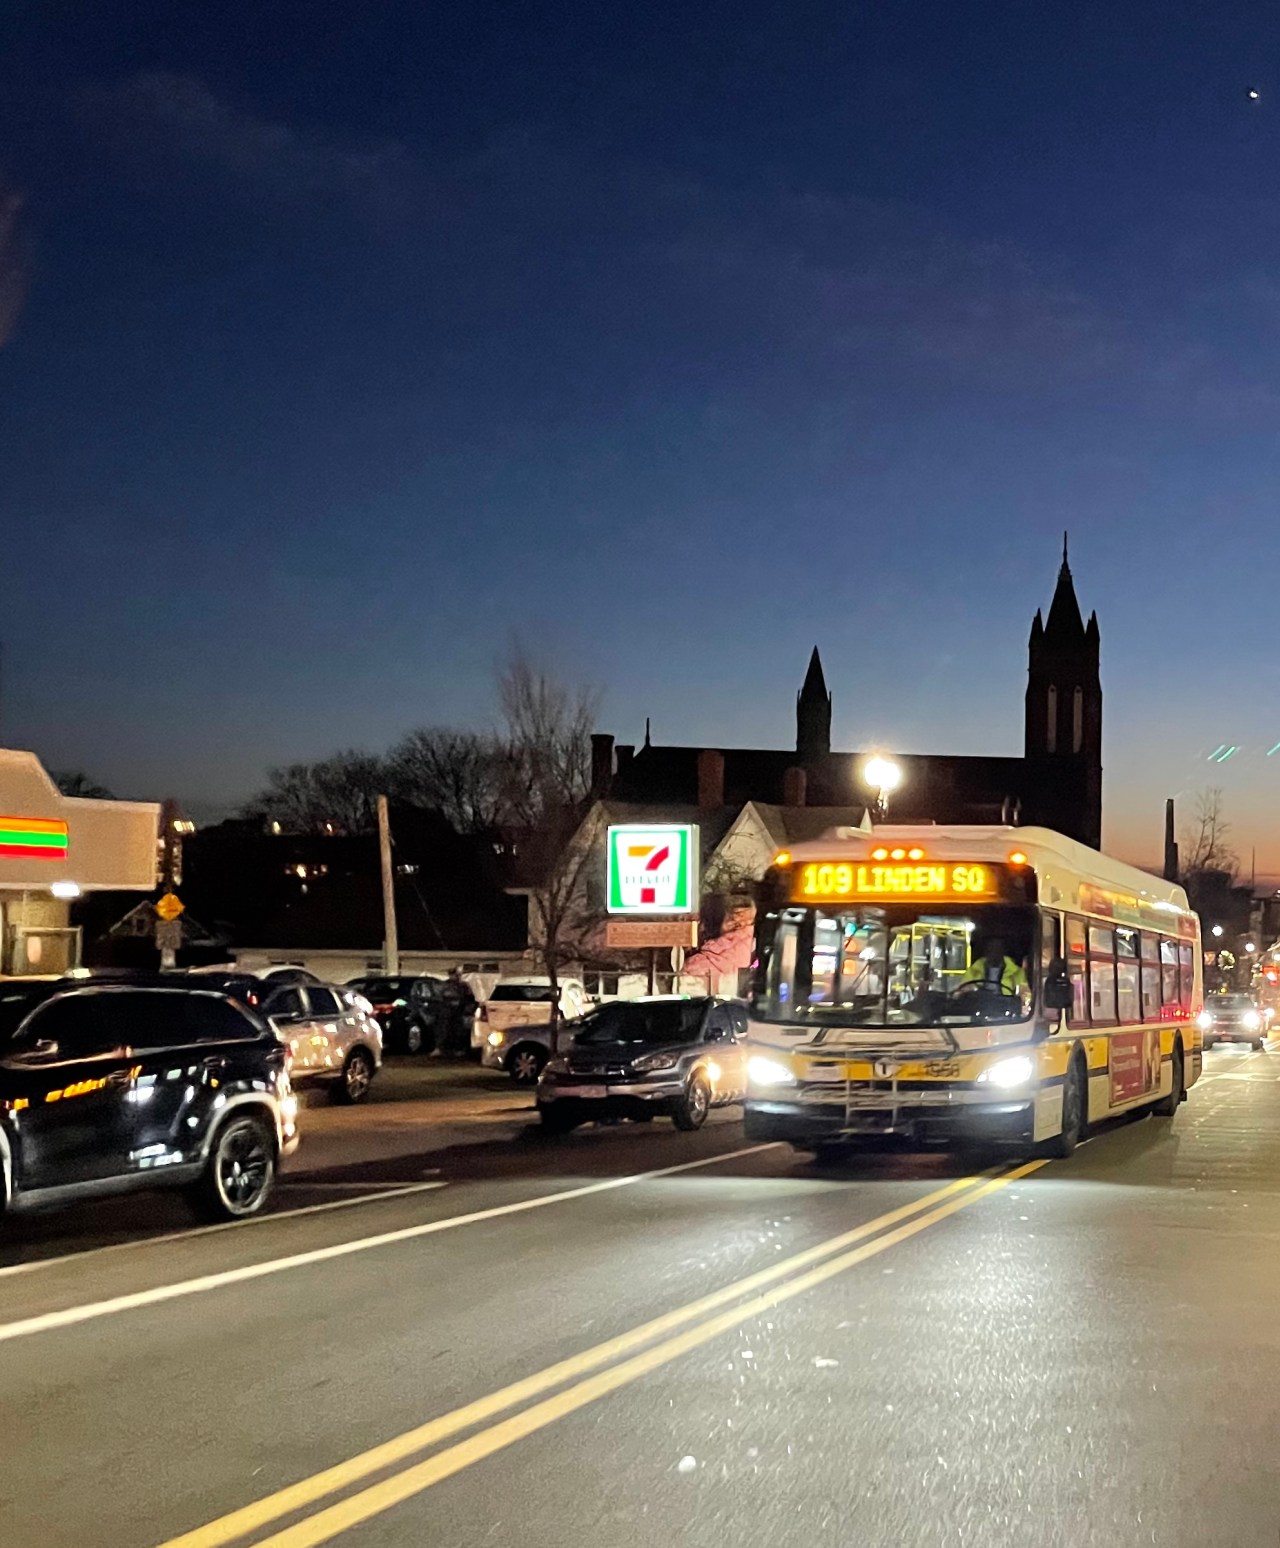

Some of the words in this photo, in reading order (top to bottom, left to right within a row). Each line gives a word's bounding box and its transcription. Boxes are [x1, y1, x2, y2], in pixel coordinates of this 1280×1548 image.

[804, 864, 852, 894] 109
[857, 866, 945, 893] LINDEN
[951, 866, 985, 893] SQ
